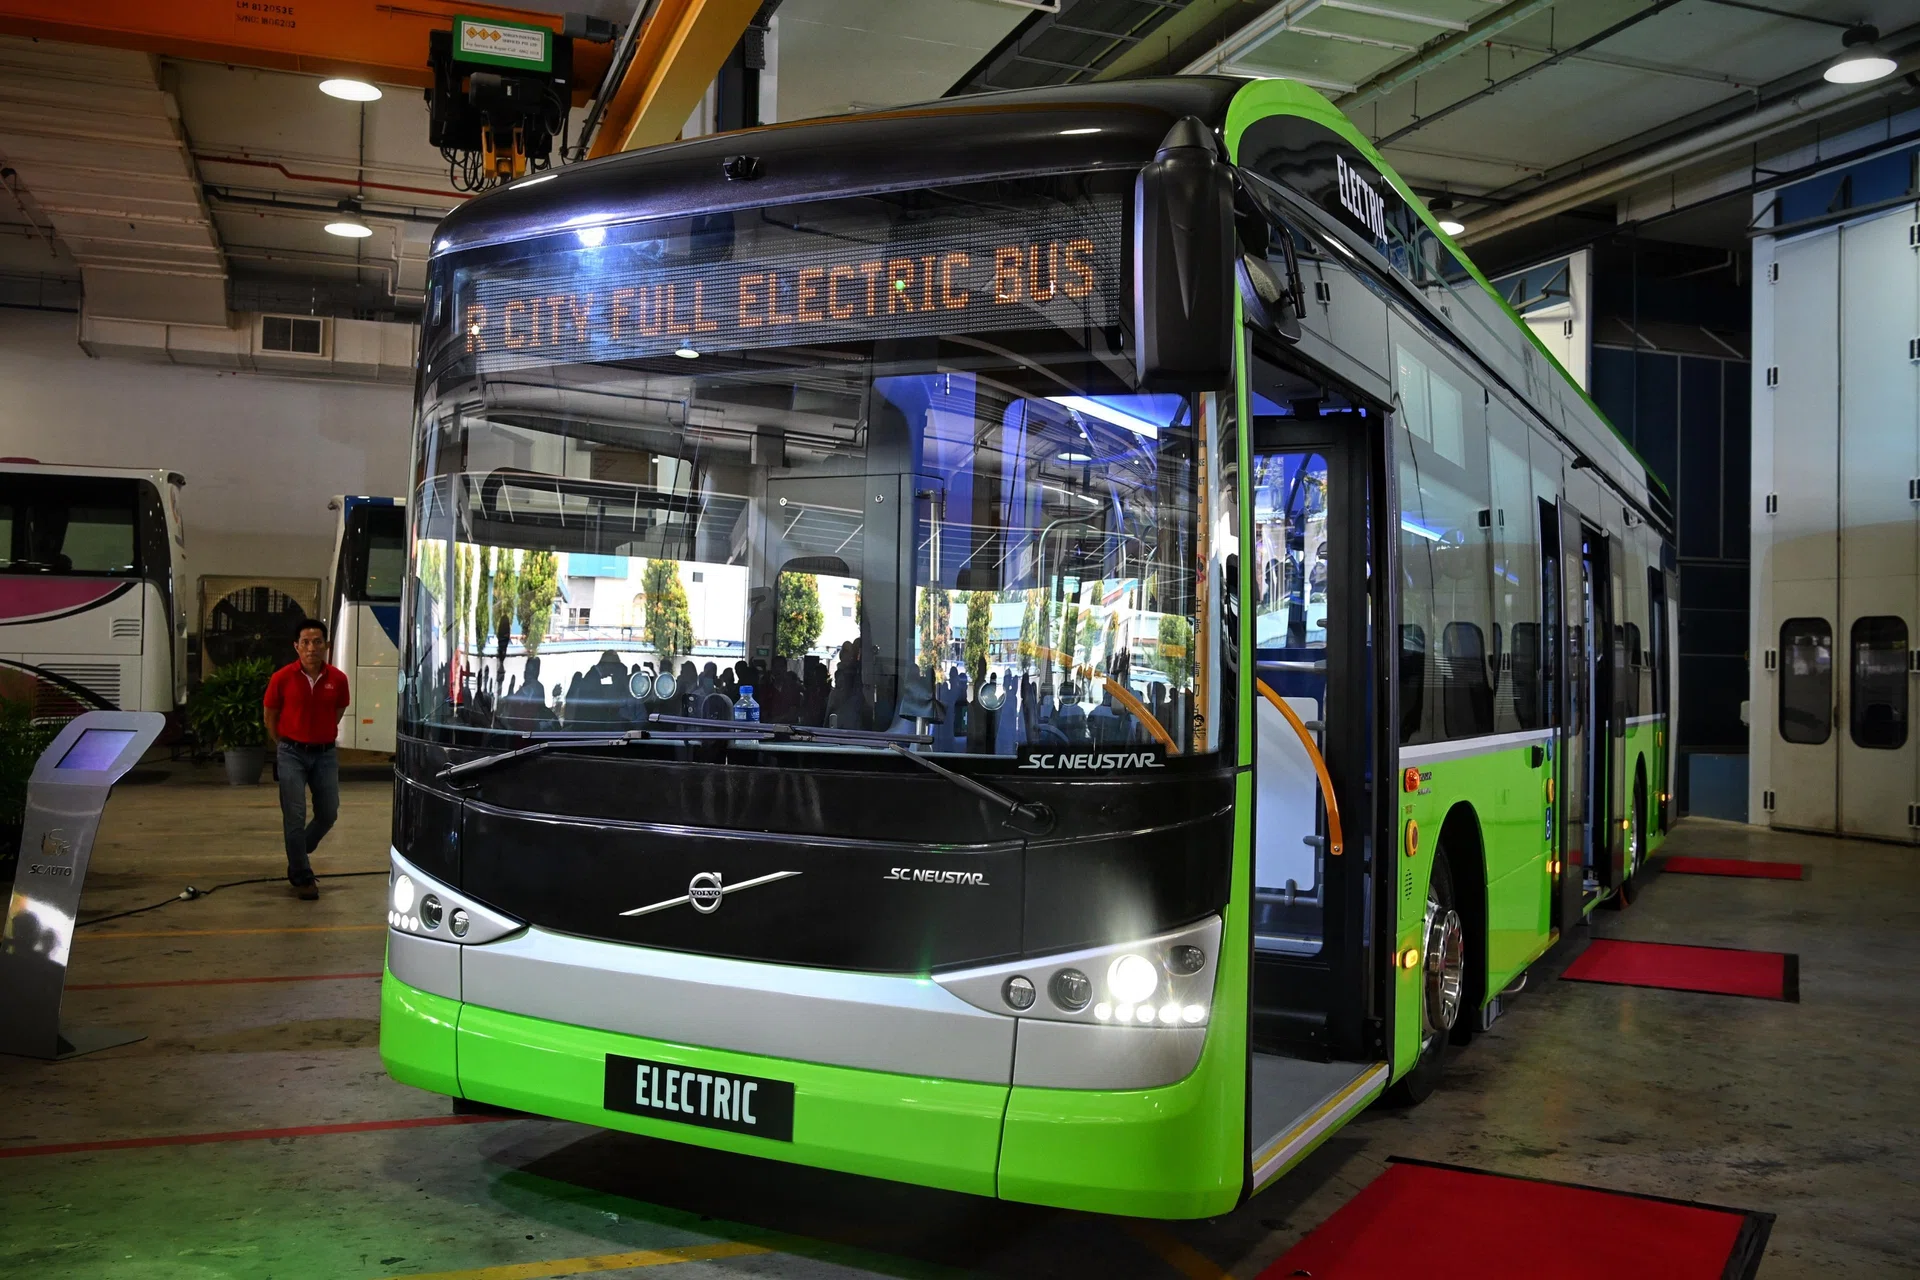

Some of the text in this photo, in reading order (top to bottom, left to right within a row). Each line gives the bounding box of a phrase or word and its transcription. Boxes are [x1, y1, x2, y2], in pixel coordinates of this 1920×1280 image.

[1336, 154, 1389, 245] ELECTRIC
[504, 293, 594, 348] CITY
[611, 281, 718, 340] FULL
[738, 251, 971, 329] ELECTRIC
[995, 238, 1094, 304] BUS
[1018, 752, 1166, 769] SC NEUSTAR
[690, 889, 722, 898] VOLVO
[883, 867, 991, 886] SC NEUSTAR
[635, 1064, 758, 1125] ELECTRIC
